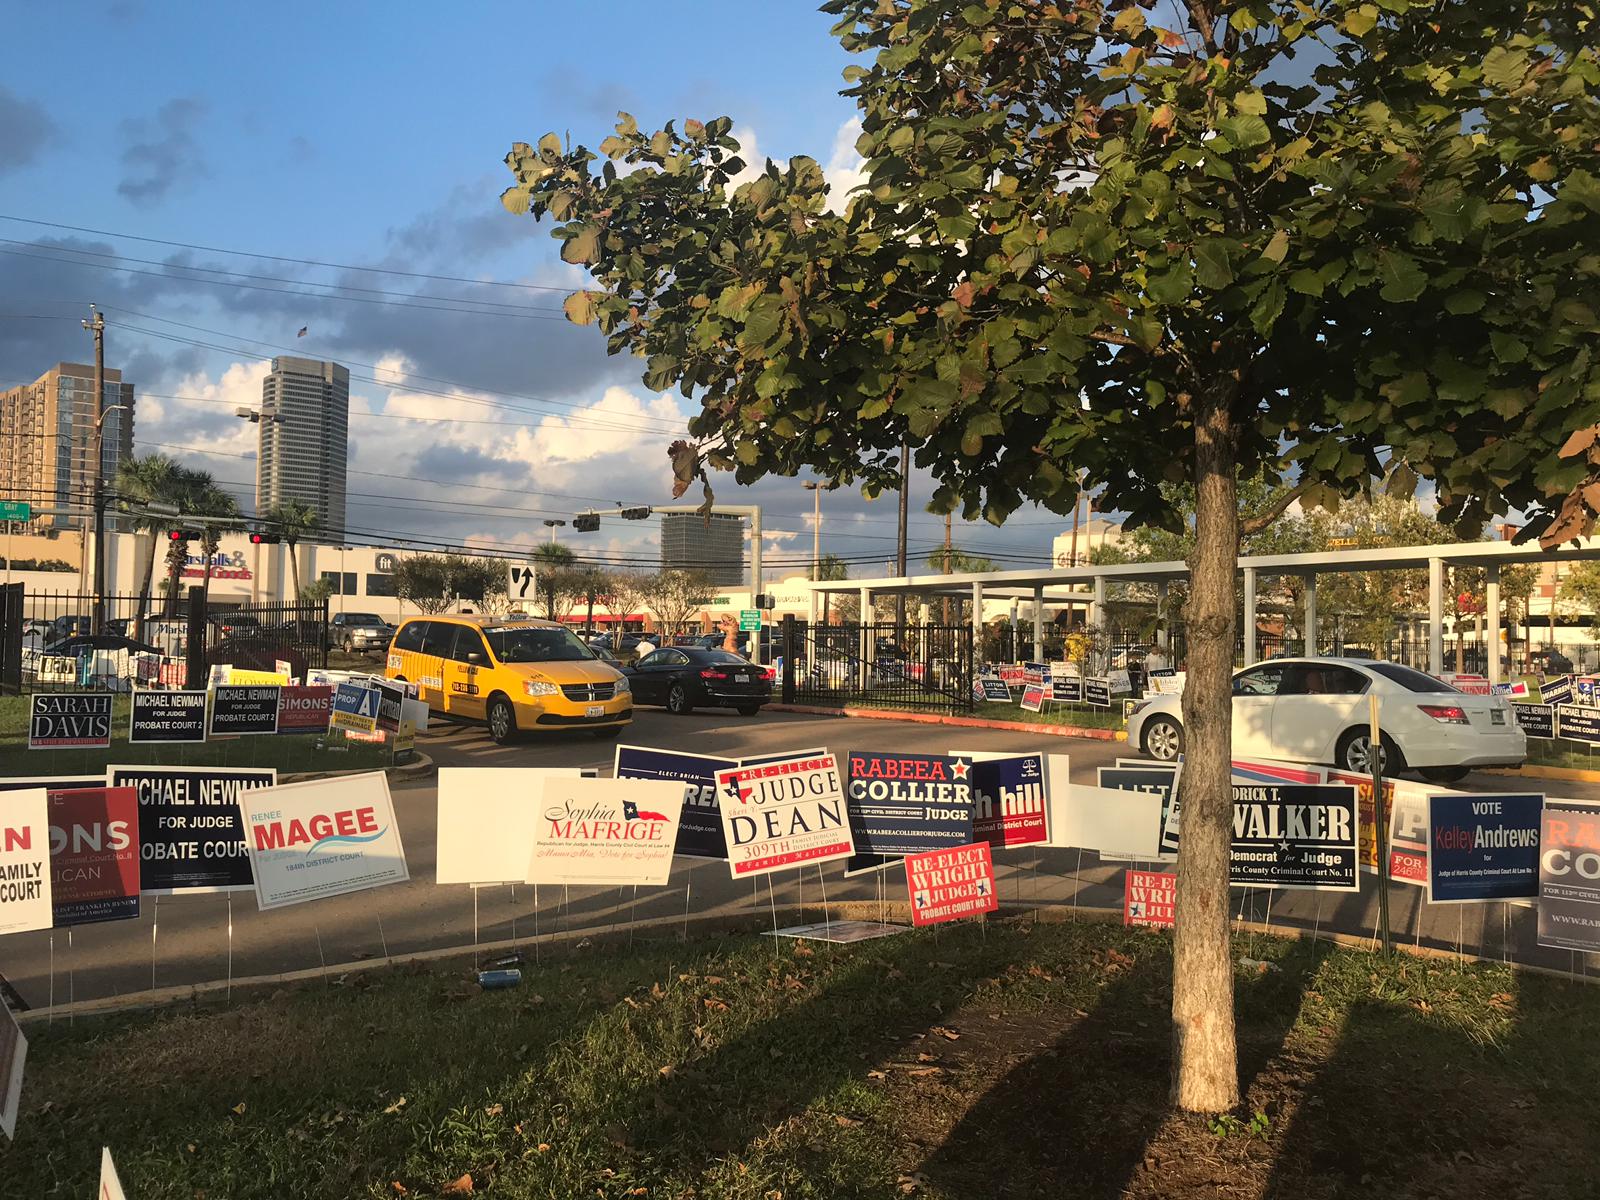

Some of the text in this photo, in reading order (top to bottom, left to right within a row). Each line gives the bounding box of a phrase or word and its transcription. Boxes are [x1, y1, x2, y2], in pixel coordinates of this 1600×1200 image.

[185, 553, 230, 565] arshalls
[136, 695, 204, 707] MICHAEL NEWMAN
[217, 690, 277, 700] MICHAEL NEWMAN
[1542, 684, 1571, 700] WARREN
[36, 697, 107, 714] SARAH
[279, 698, 329, 710] SIMONS
[337, 694, 357, 704] PROP
[358, 690, 371, 716] A
[33, 716, 108, 738] DAVIS
[135, 721, 203, 729] PROBATE COURT 2
[215, 714, 246, 722] PROBATE
[749, 760, 827, 780] RE-ELECT
[851, 758, 947, 780] RABEEA
[752, 771, 839, 805] JUDGE
[849, 780, 972, 804] COLLIER
[1270, 788, 1281, 801] T.
[999, 782, 1042, 817] hill
[1472, 802, 1503, 815] VOTE
[251, 810, 282, 822] RENEE
[544, 798, 617, 827] Sophia
[925, 808, 969, 821] JUDGE
[158, 816, 234, 829] FOR JUDGE
[253, 806, 379, 852] MAGEE
[548, 820, 664, 841] MAFRIGE
[728, 800, 843, 846] DEAN
[973, 818, 1043, 832] riminal District Court
[1231, 804, 1352, 842] WALKER
[0, 826, 32, 852] N
[141, 841, 199, 861] OBATE
[743, 840, 790, 859] 309TH
[1483, 854, 1493, 862] for
[306, 854, 339, 869] DISTRICT
[339, 850, 364, 862] COURT
[911, 847, 986, 874] RE-ELECT
[1284, 854, 1296, 863] for
[1301, 852, 1342, 867] Judge
[1394, 855, 1423, 869] FOR
[1541, 849, 1600, 880] CO
[51, 865, 101, 884] ICAN
[911, 861, 989, 890] WRIGHT
[1242, 866, 1354, 877] County Criminal Court No. 11
[931, 882, 977, 904] JUDGE
[1544, 887, 1560, 895] FOR
[920, 904, 952, 920] PROBATE
[951, 900, 976, 914] COURT
[975, 898, 988, 910] NO.
